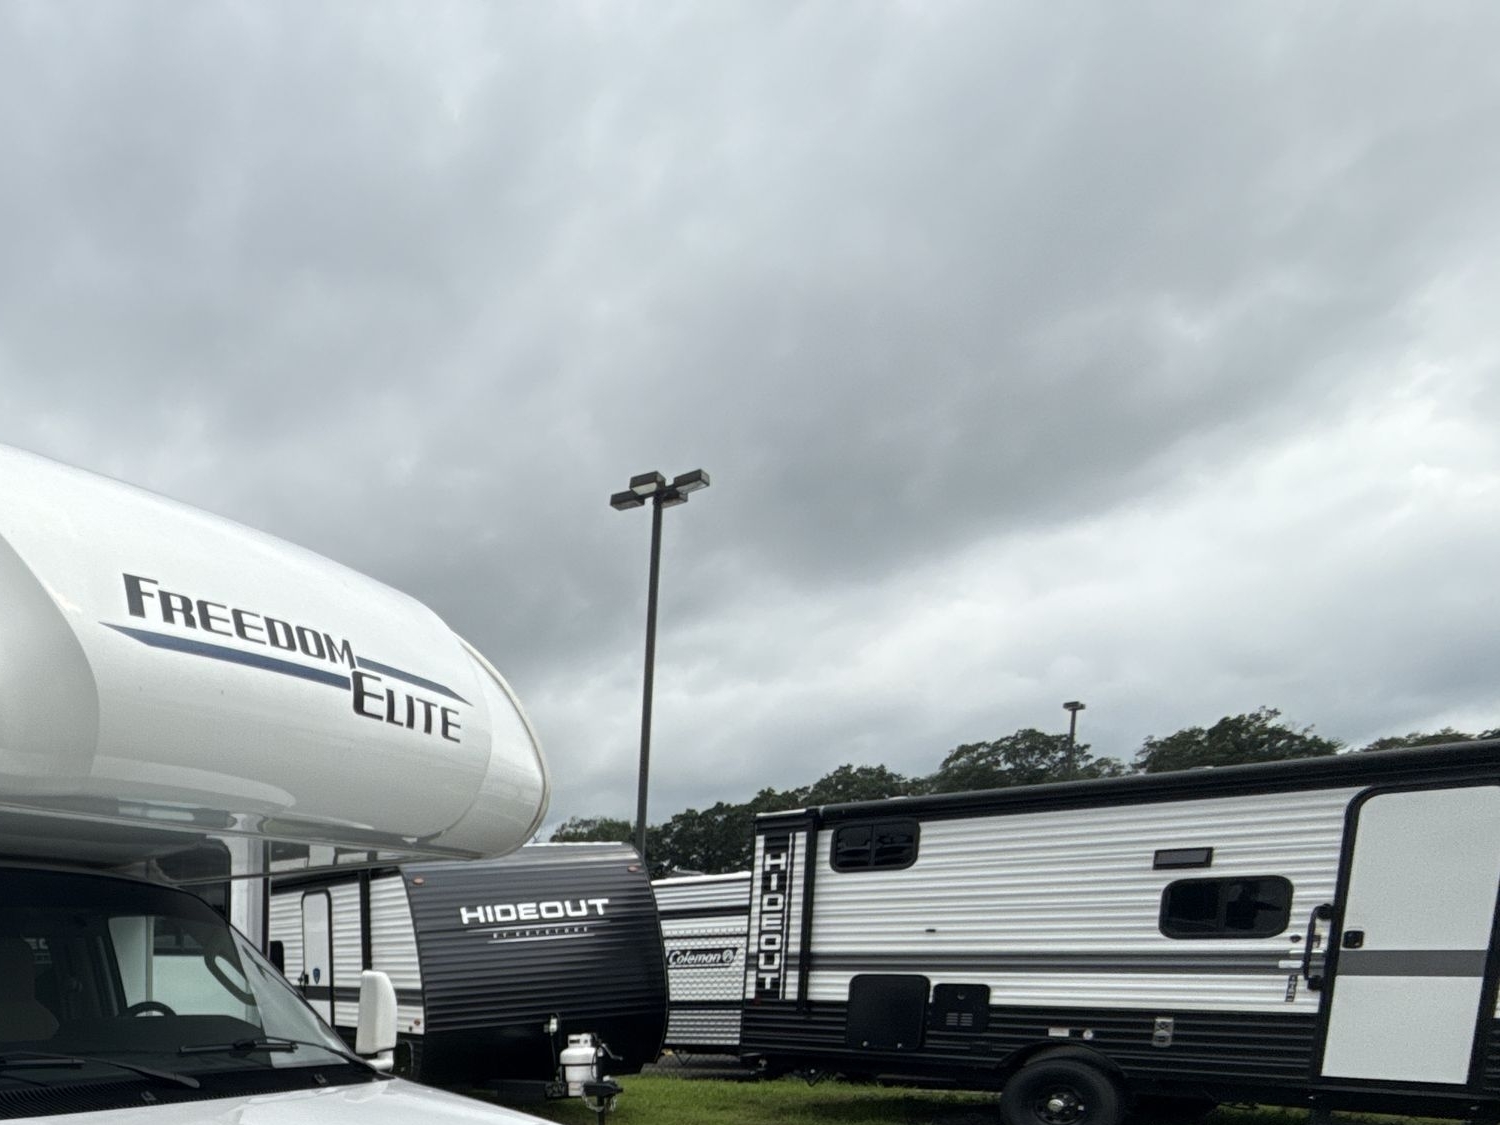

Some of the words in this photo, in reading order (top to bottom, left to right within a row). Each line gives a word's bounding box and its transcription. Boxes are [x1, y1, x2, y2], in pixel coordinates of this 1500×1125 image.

[122, 573, 357, 669] FREEDOM
[351, 670, 461, 743] ELITE
[459, 898, 610, 925] HIDEOUT
[757, 852, 787, 990] HIDEOUT
[668, 950, 721, 966] Coleman
